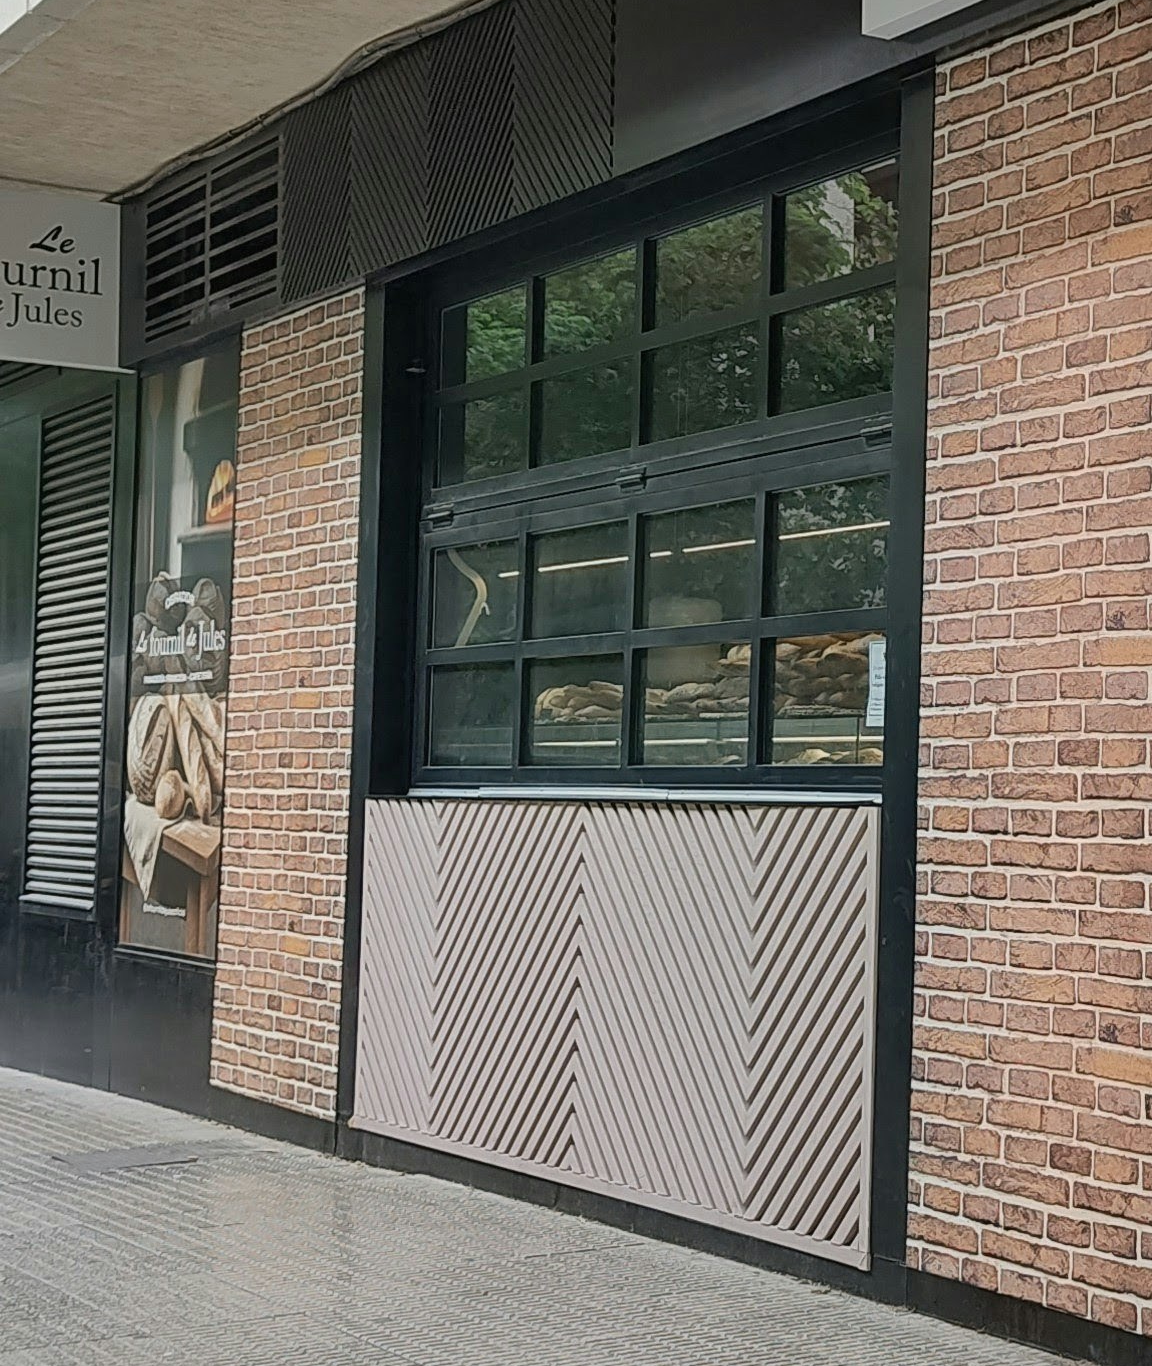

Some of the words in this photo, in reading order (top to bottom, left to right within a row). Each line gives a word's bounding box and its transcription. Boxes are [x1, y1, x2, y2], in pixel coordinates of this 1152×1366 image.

[29, 225, 75, 253] Le
[6, 292, 84, 327] Jules
[196, 619, 226, 661] Jules
